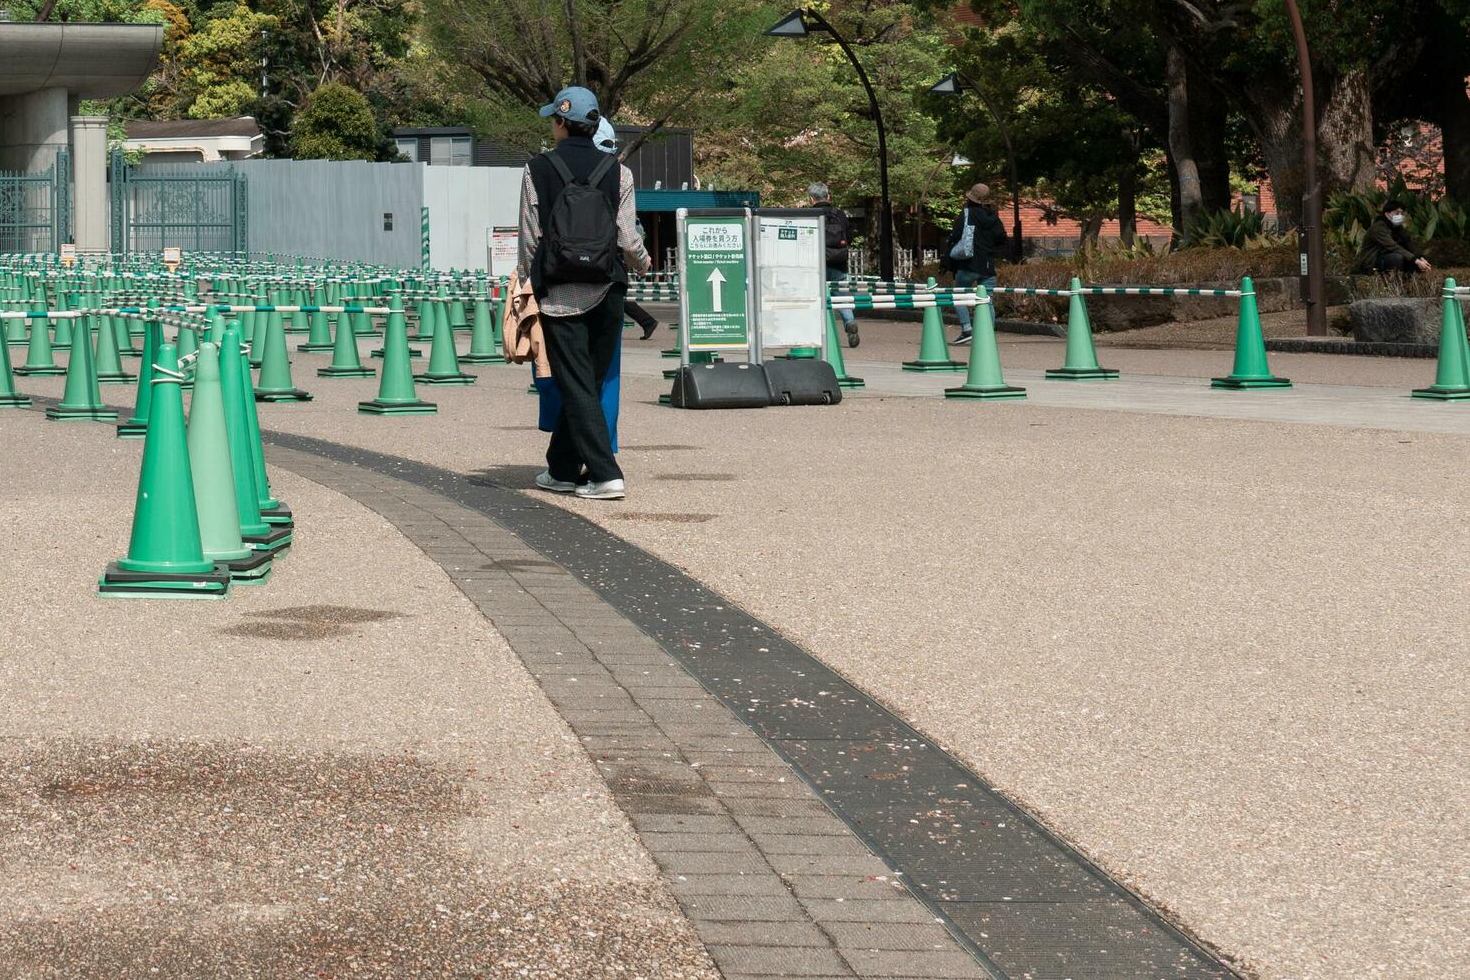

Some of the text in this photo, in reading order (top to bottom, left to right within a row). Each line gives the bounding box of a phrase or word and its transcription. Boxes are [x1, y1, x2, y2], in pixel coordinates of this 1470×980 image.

[693, 234, 738, 242] 入場券を買う方
